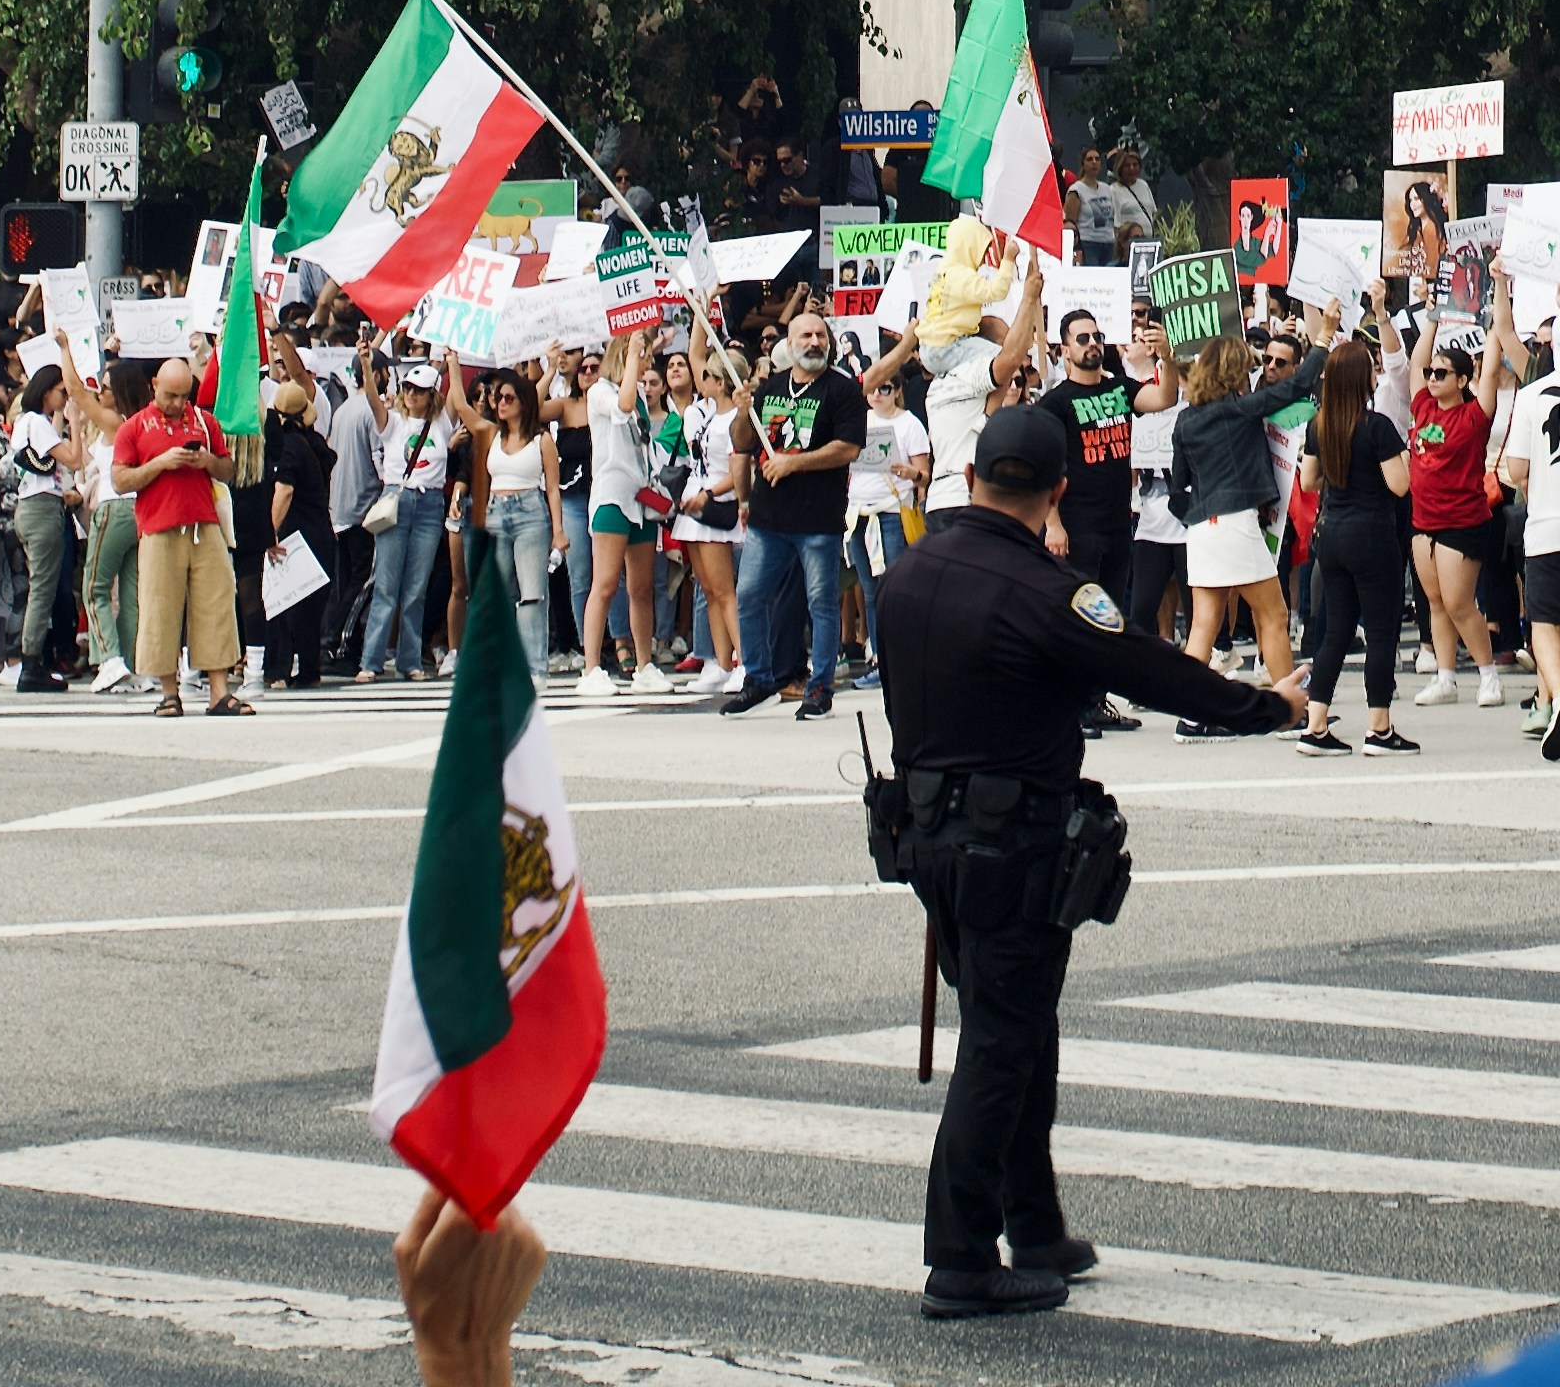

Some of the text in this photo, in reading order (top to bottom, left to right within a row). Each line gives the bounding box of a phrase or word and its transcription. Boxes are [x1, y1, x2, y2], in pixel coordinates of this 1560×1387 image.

[845, 114, 918, 136] Wilshire
[1393, 100, 1500, 135] #MAHSAMINI
[70, 126, 129, 140] DIAGONAL
[71, 142, 129, 154] CROSSING
[65, 164, 91, 192] OK
[1503, 187, 1523, 199] Medi
[626, 235, 689, 253] WMEN
[838, 224, 947, 254] WOMEN LIFE
[598, 246, 648, 275] WOMEN
[103, 282, 135, 294] CROSS
[445, 253, 505, 305] REE
[616, 278, 642, 299] LIFE
[1152, 257, 1231, 308] MAHSA
[426, 297, 501, 354] IRAN
[609, 304, 659, 331] FREEDOM
[1164, 301, 1222, 348] AMINI
[1081, 423, 1130, 448] WOME
[1084, 444, 1106, 464] OF
